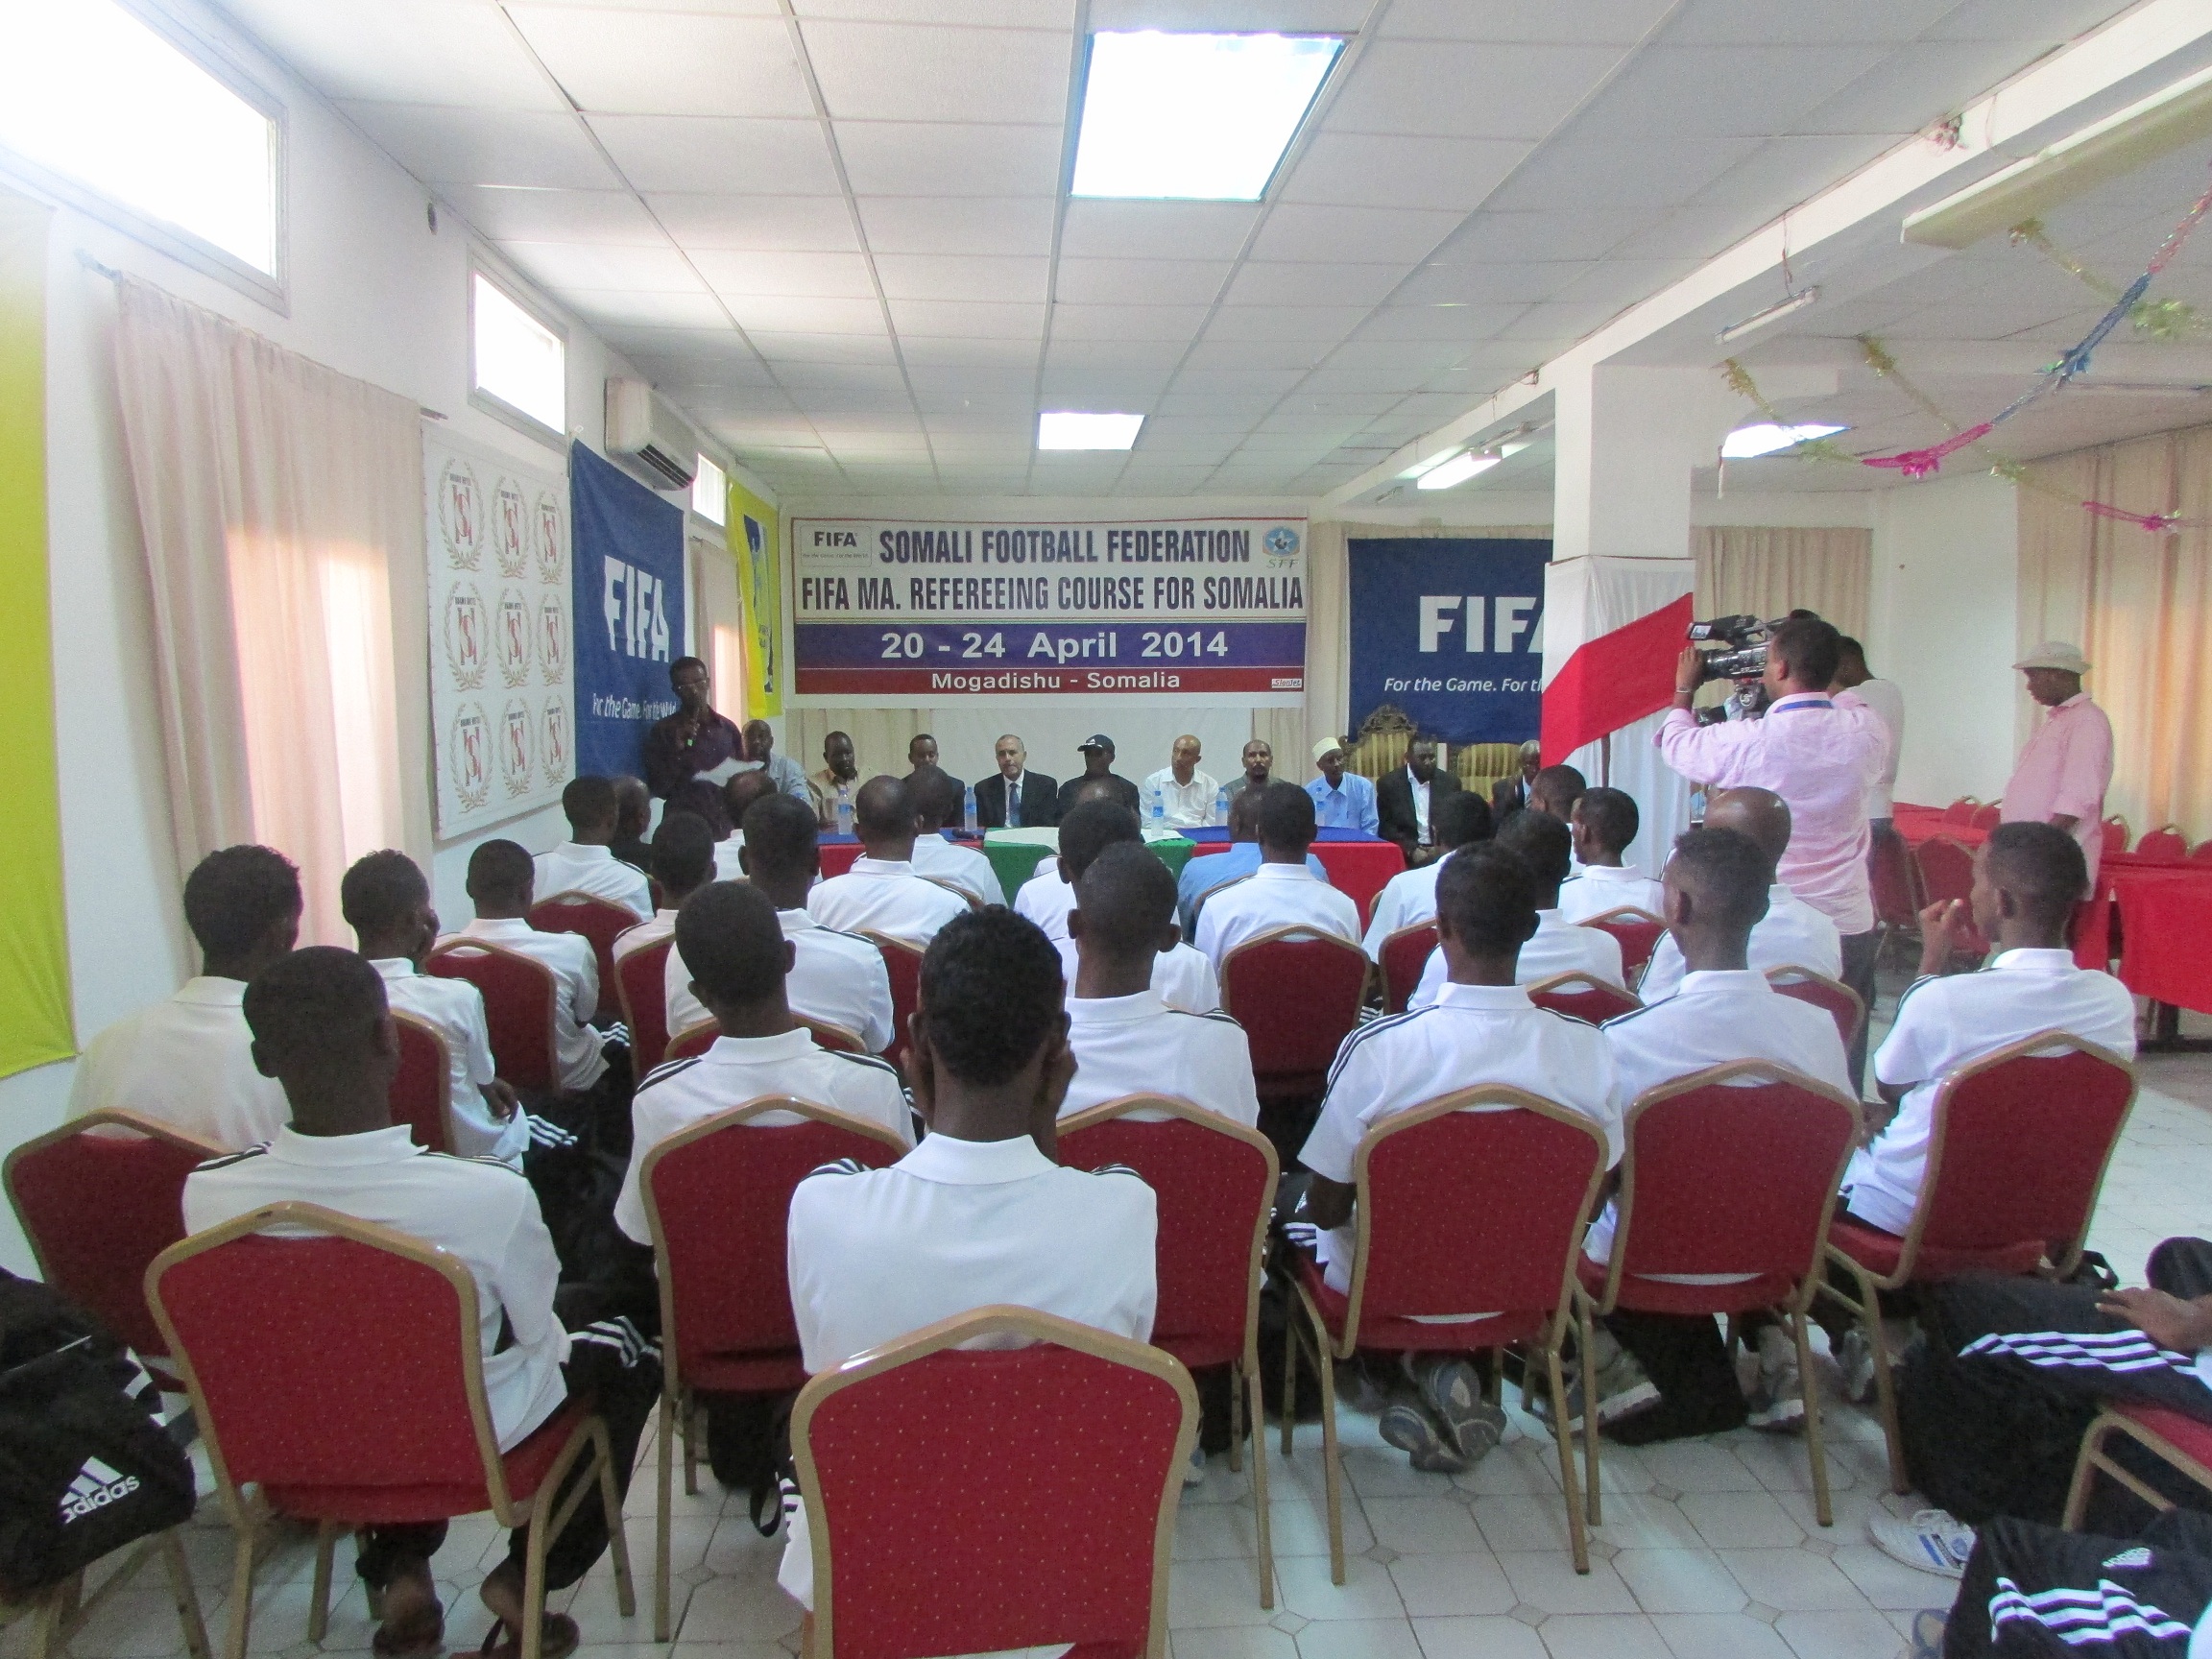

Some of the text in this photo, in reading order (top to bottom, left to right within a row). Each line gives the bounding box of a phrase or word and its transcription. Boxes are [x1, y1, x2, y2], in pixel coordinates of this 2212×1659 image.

[814, 531, 857, 546] FIFA
[879, 529, 1250, 563] SOMALI FOOTBALL FEDERATION
[802, 576, 1304, 610] FIFA MA. REFEREEING COURSE FOR SOMALIA
[604, 555, 670, 662] FIFA
[880, 632, 924, 659] 20
[962, 632, 1006, 659] 24
[1026, 632, 1117, 664] April
[1141, 631, 1228, 658] 2014
[931, 672, 1061, 692] Mogadishu
[1087, 671, 1180, 688] Somalia
[1384, 678, 1410, 692] For
[1413, 678, 1441, 692] the
[1446, 678, 1497, 692] Game.
[1501, 678, 1528, 692] For
[604, 694, 622, 718] the
